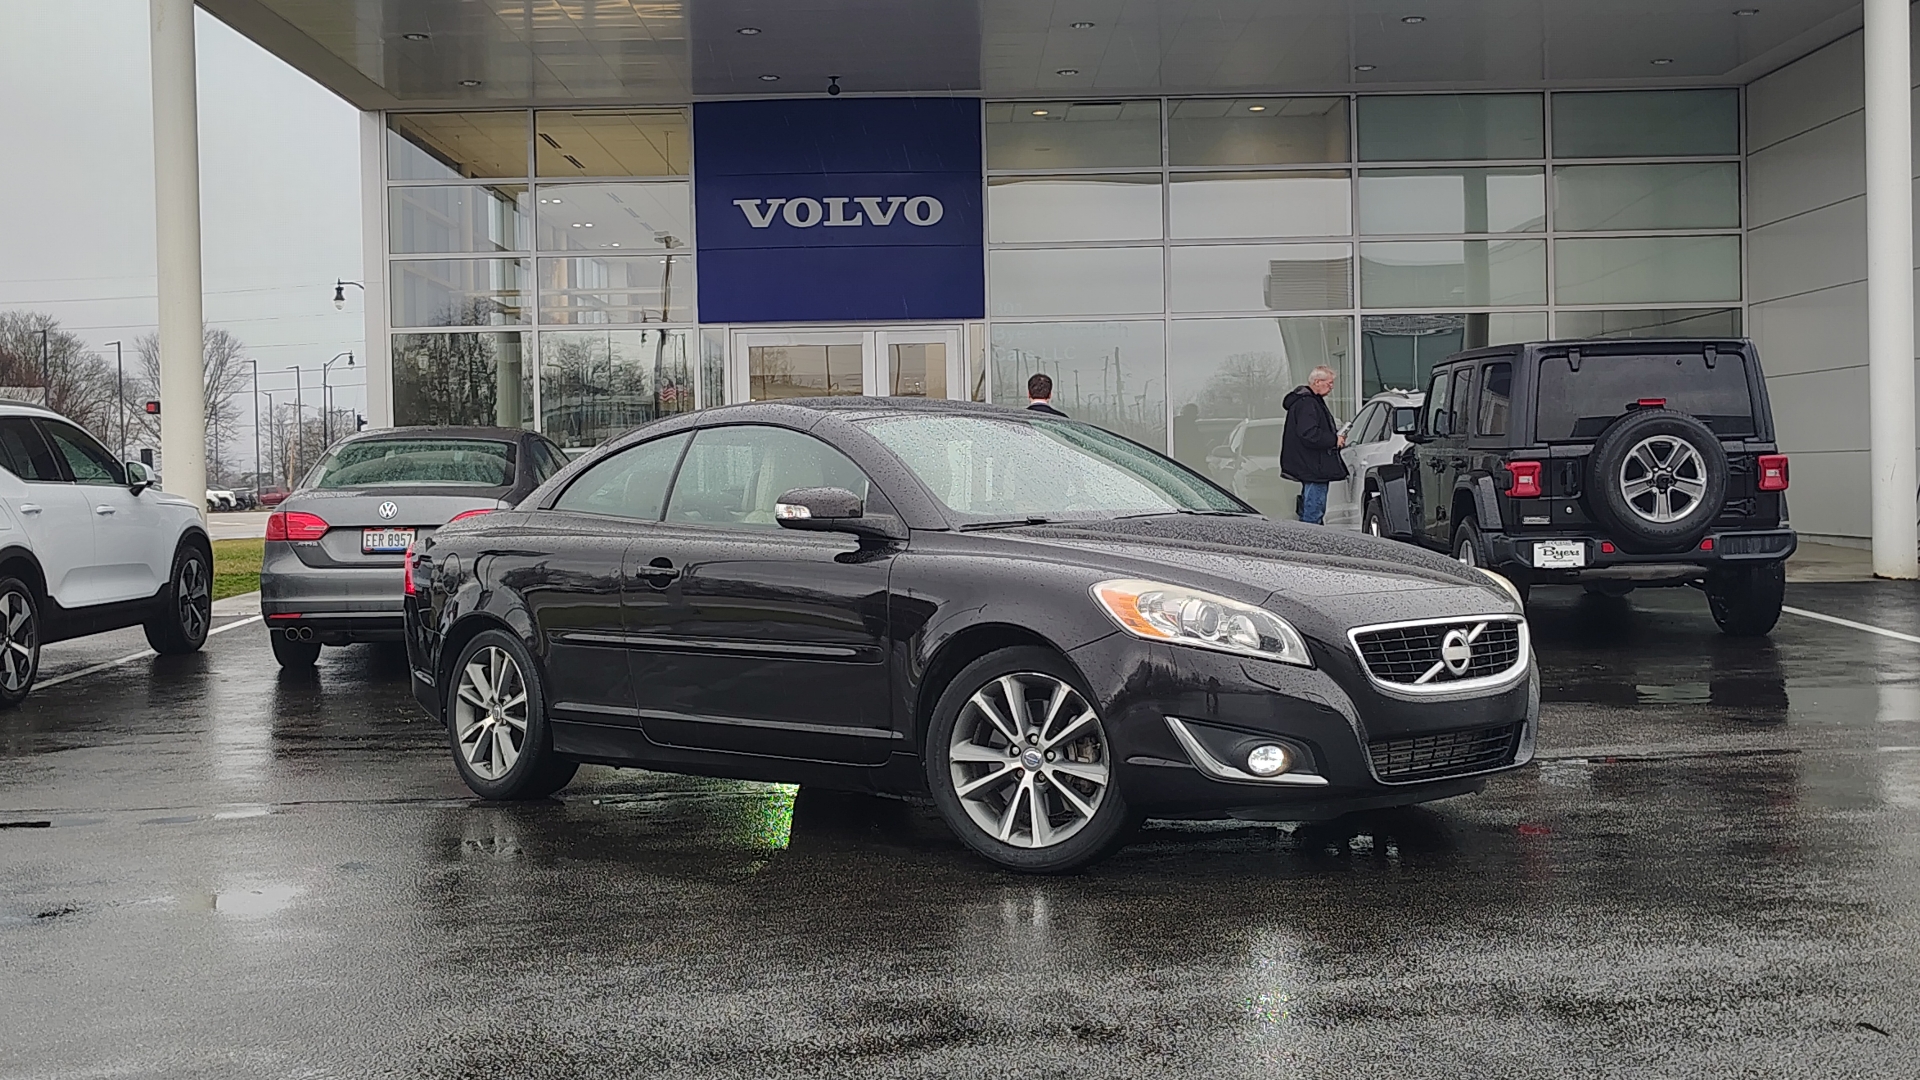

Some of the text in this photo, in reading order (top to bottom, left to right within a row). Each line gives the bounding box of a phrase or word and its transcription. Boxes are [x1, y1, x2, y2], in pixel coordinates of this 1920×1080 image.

[733, 196, 944, 228] VOLVO
[1042, 346, 1077, 361] LLC
[365, 533, 413, 547] EER 8957
[1538, 546, 1580, 560] Byers
